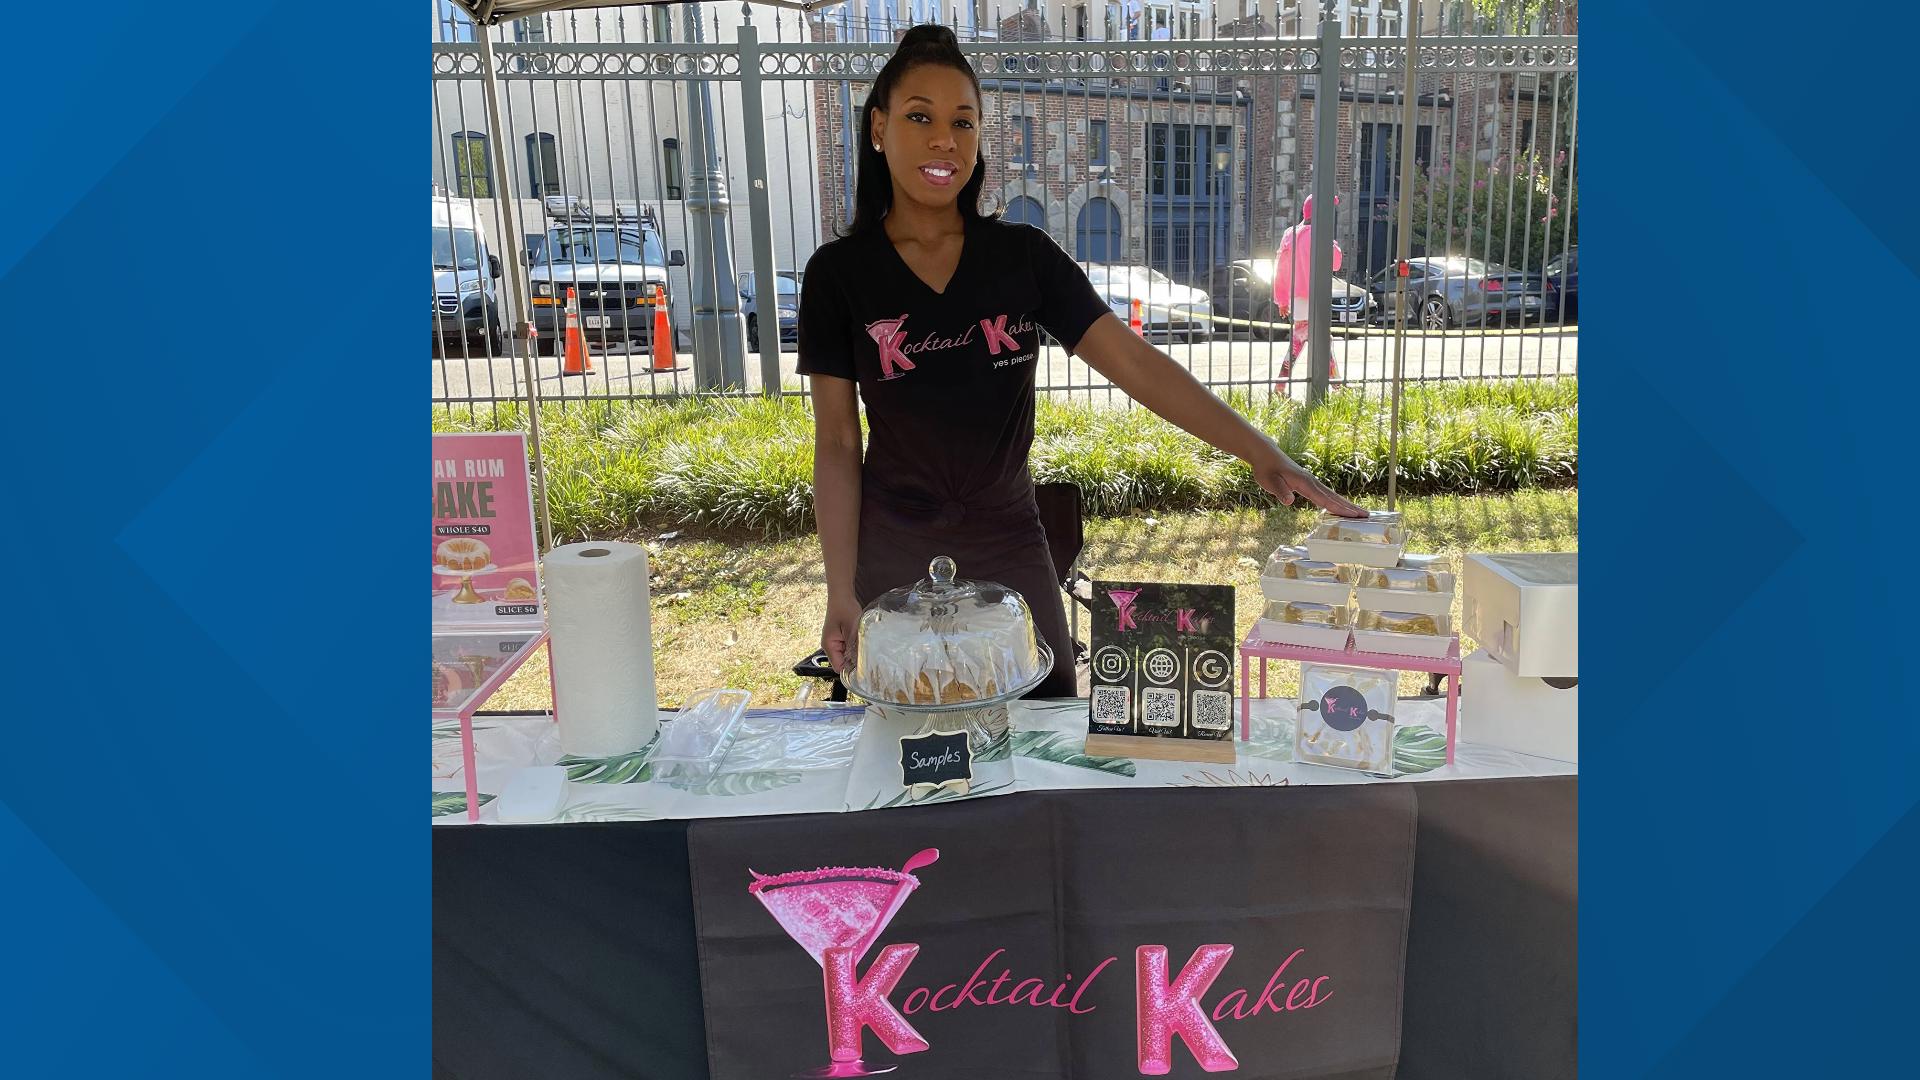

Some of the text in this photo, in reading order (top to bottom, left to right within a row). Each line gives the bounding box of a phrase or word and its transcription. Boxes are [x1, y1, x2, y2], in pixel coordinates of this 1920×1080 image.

[878, 324, 977, 376] Kocktail
[993, 360, 1009, 369] yes
[464, 458, 505, 478] RUM
[438, 526, 470, 534] WHOLE
[498, 606, 523, 614] SLICE
[1202, 659, 1222, 679] G
[909, 746, 961, 773] Samples
[822, 943, 1335, 1076] Kocktail Kakes
